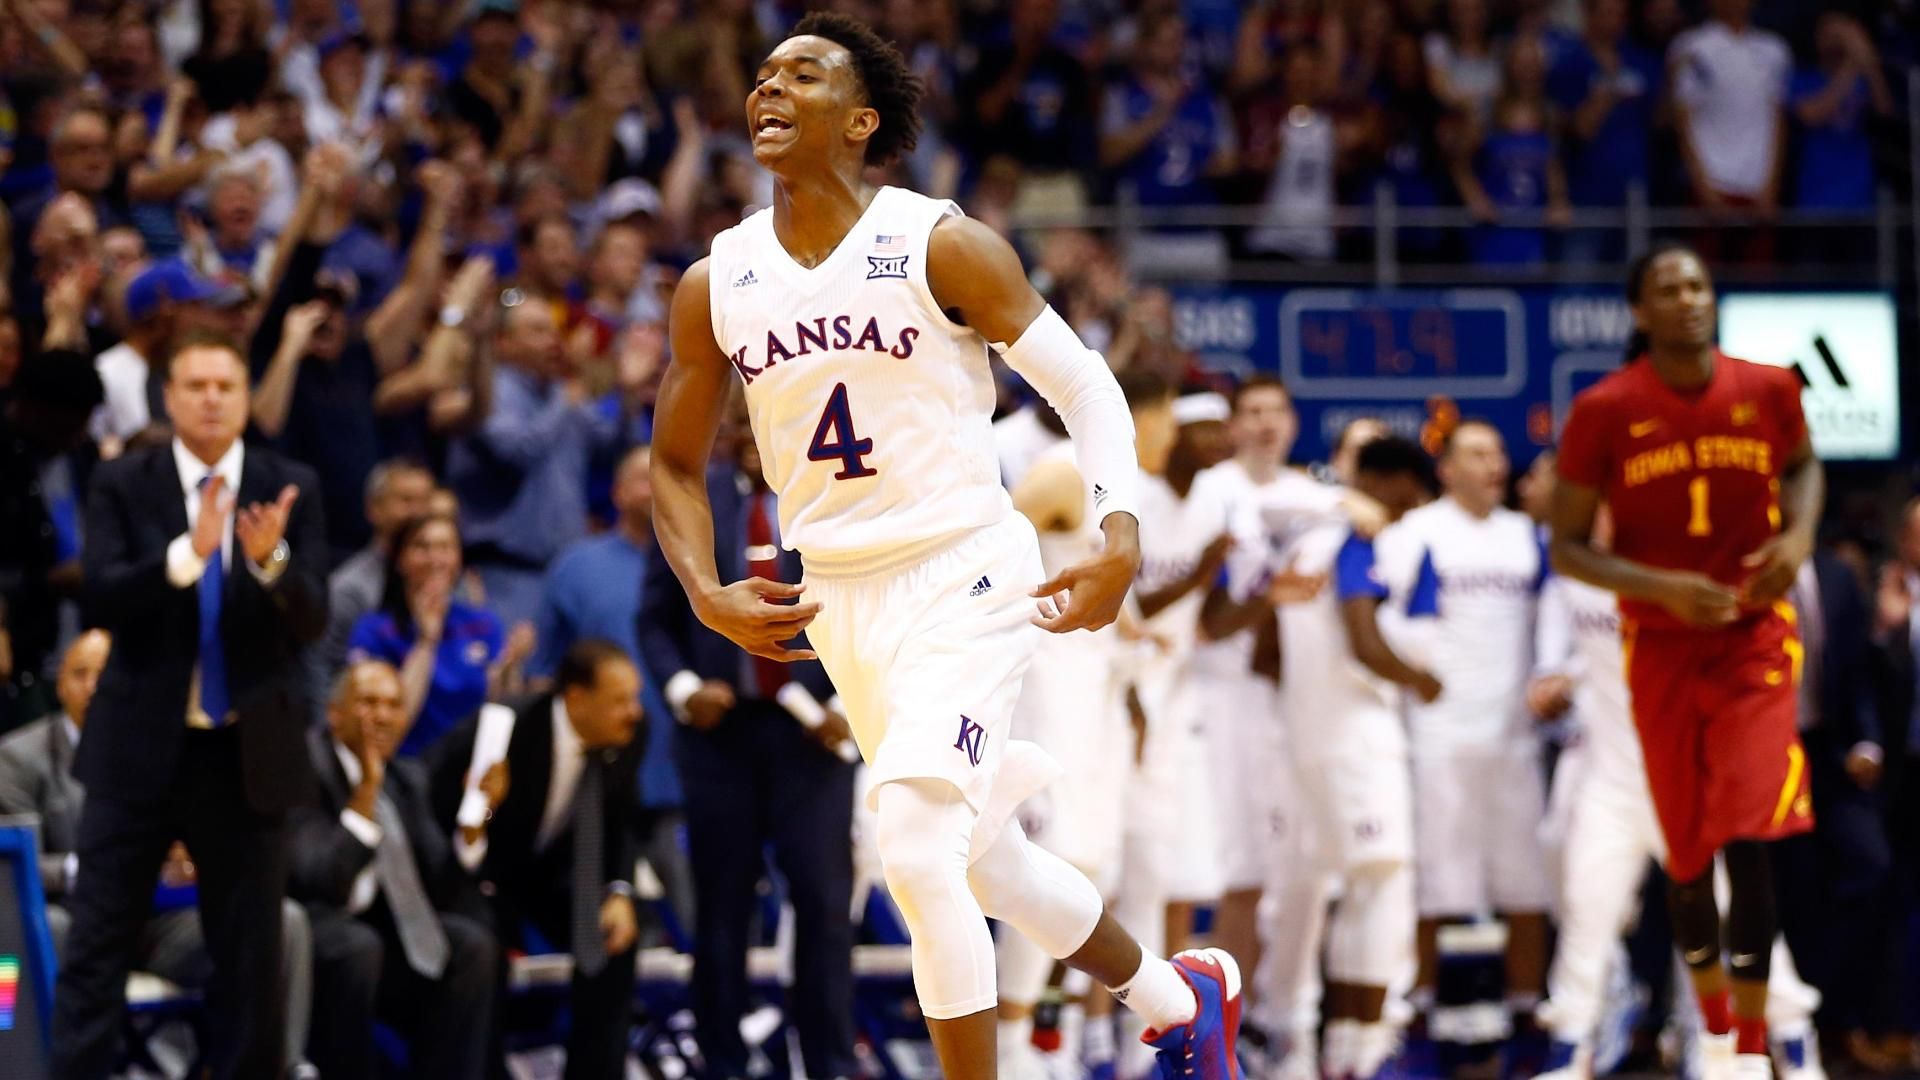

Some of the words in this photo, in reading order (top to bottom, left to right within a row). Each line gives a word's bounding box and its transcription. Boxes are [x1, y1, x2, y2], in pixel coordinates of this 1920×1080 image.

[731, 315, 919, 385] KANSAS
[807, 382, 878, 480] 4
[1624, 441, 1691, 487] IOWA
[1695, 435, 1771, 475] STATE
[1688, 475, 1711, 536] 1
[953, 714, 988, 767] KU
